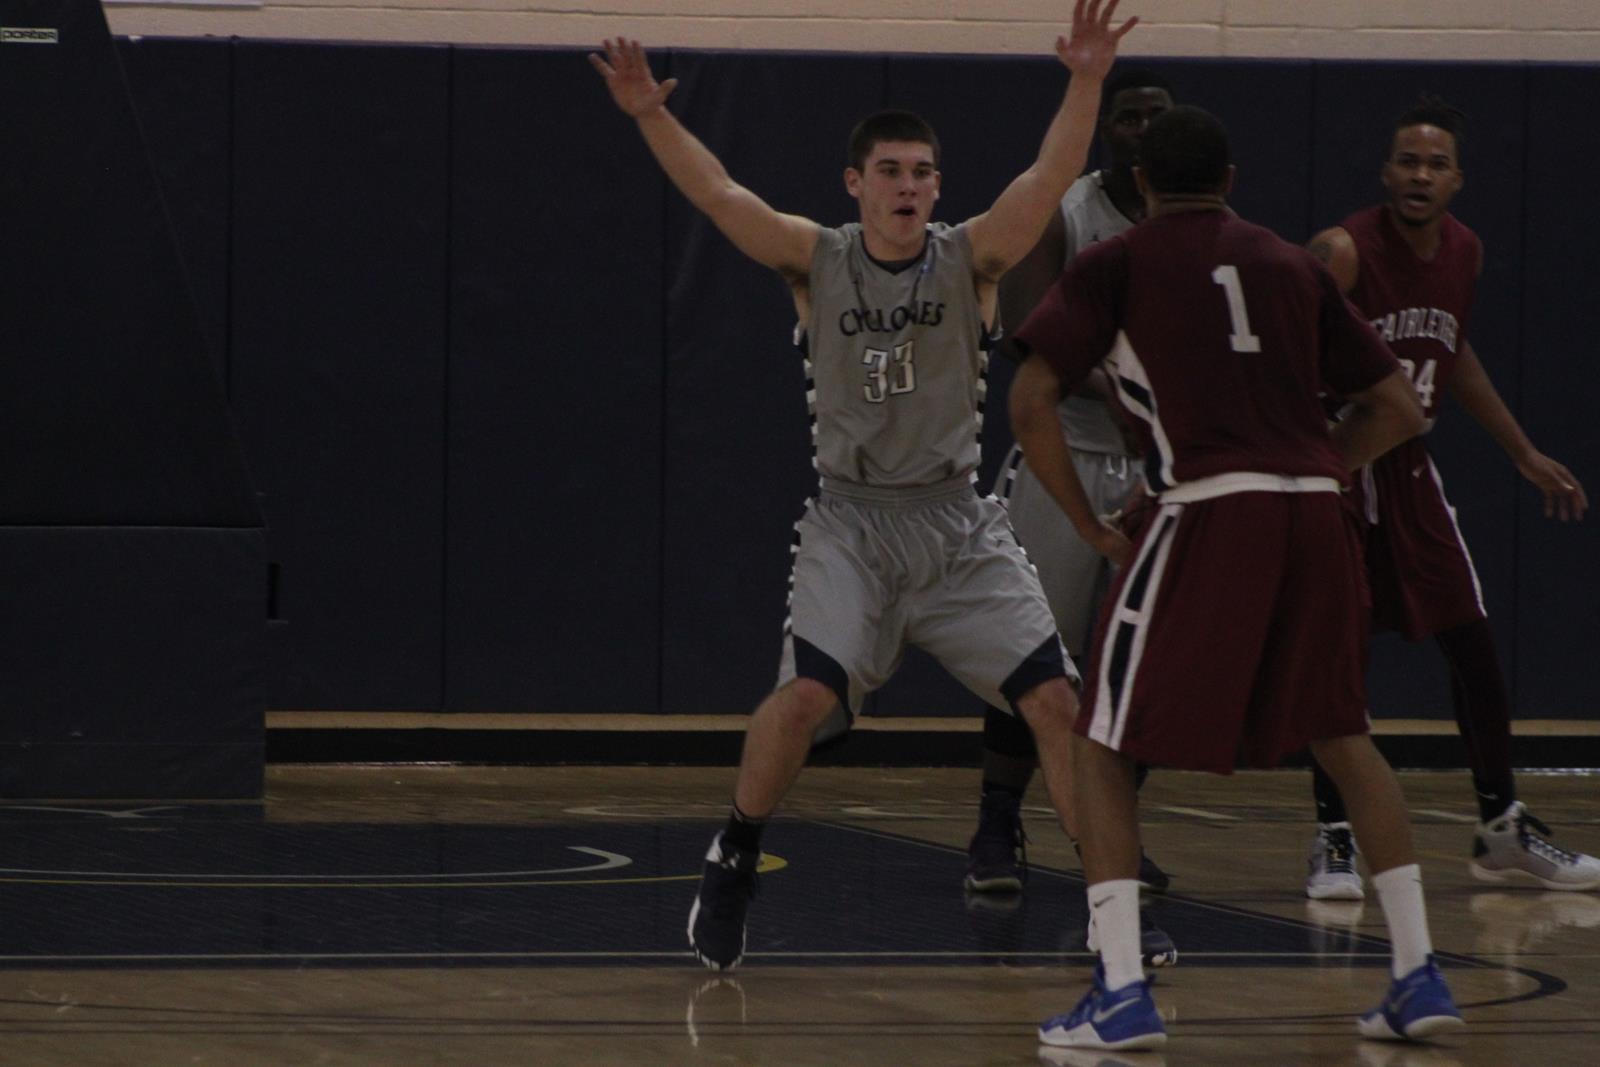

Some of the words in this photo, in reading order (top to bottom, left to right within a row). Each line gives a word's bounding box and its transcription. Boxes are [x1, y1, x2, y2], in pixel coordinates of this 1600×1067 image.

[839, 301, 945, 336] CYCLONES
[1211, 264, 1262, 353] 1
[862, 340, 917, 403] 33
